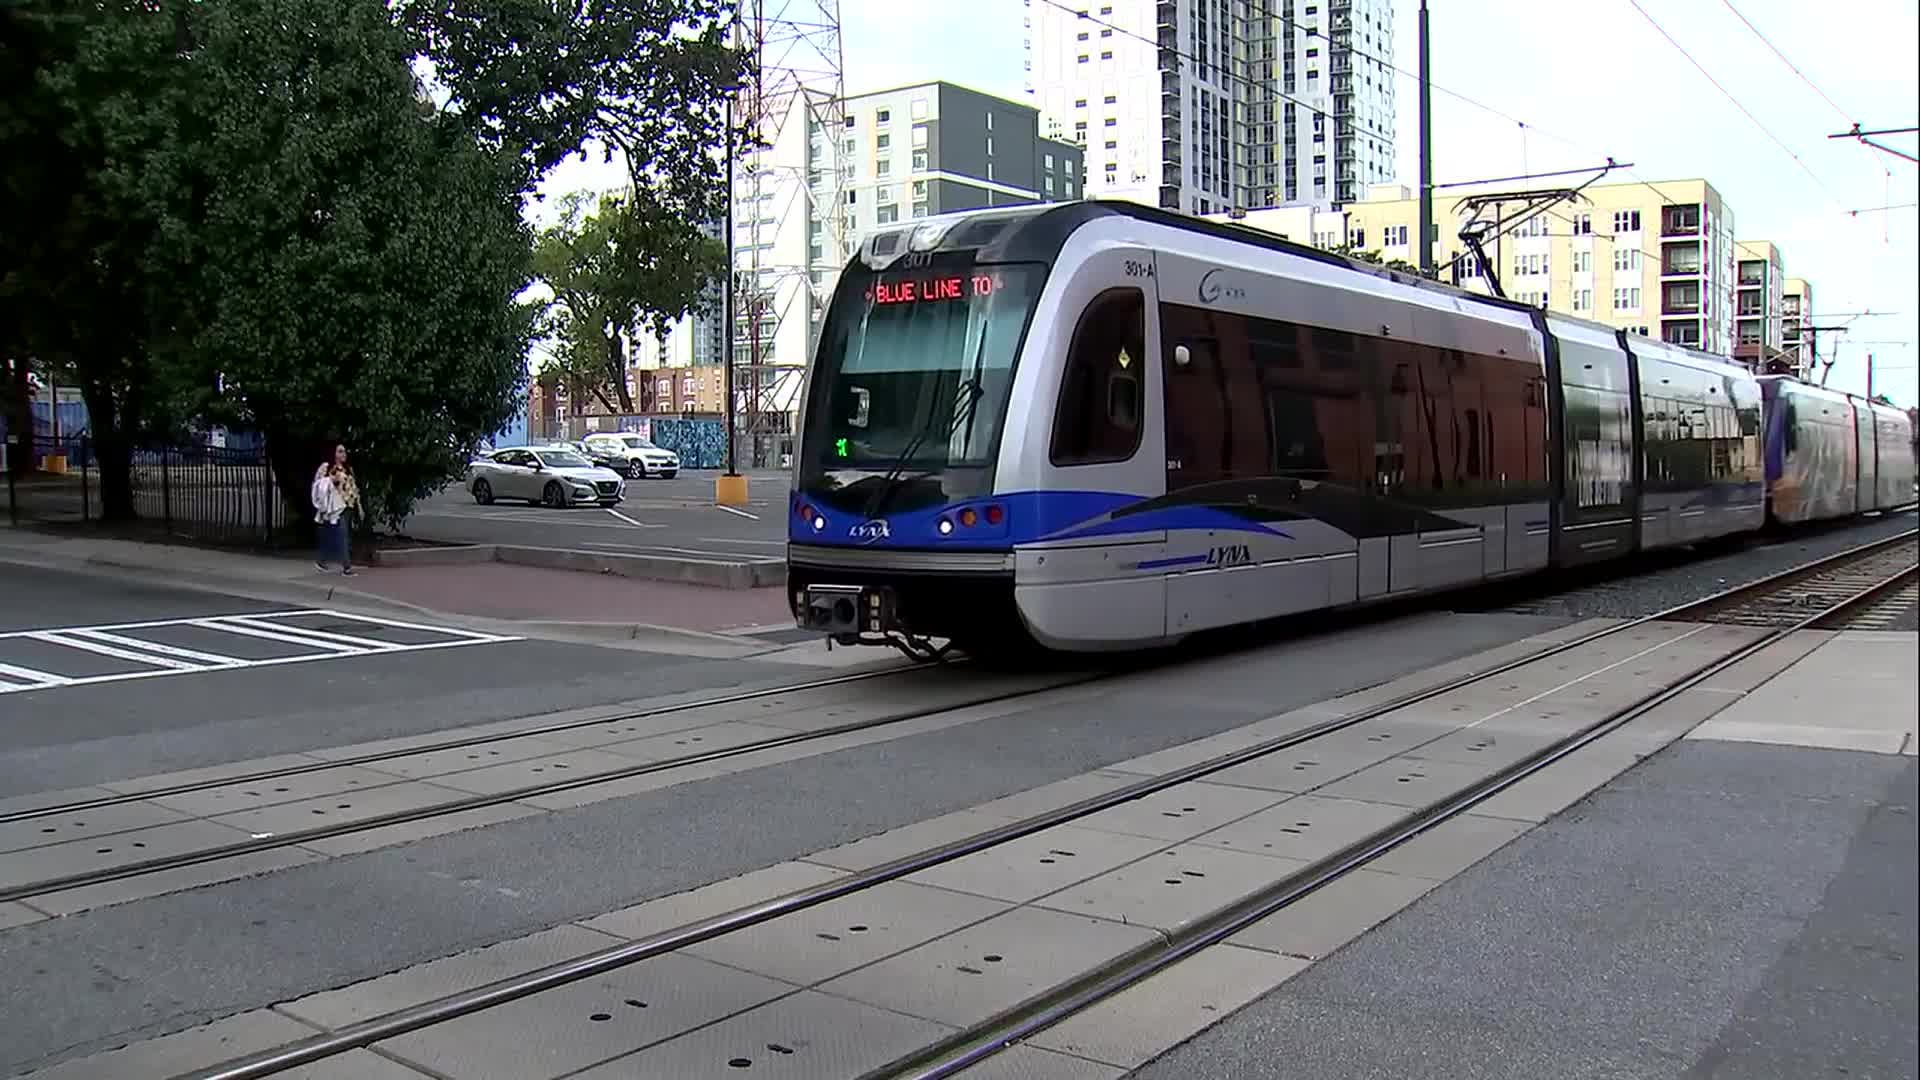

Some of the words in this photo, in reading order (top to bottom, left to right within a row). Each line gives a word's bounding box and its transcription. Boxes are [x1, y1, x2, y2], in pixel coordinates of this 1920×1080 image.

[1125, 260, 1155, 278] 301-A
[876, 283, 915, 303] BLUE
[924, 279, 962, 300] LINE
[971, 276, 992, 296] TO
[848, 525, 891, 538] LYNX
[1206, 544, 1251, 564] LYNX
